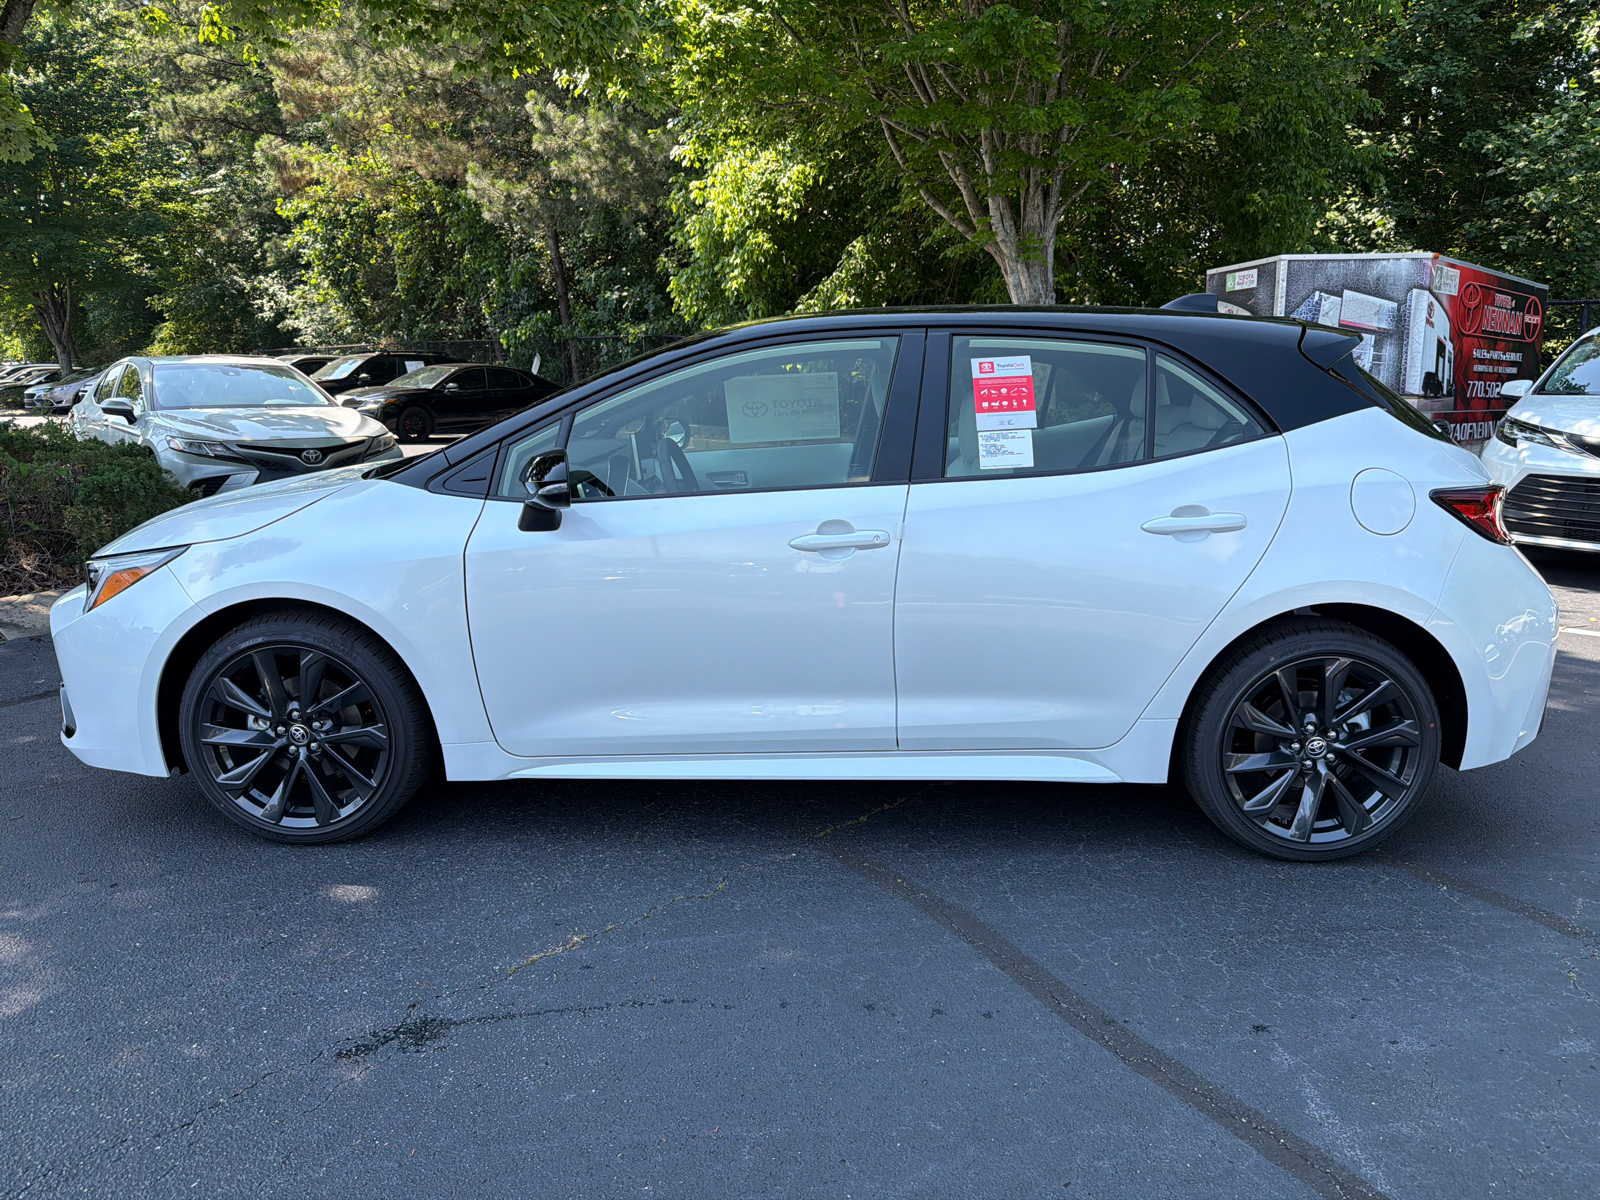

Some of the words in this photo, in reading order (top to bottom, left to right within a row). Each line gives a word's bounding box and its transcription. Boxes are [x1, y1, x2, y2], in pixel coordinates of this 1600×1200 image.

[1494, 293, 1512, 309] TOYOTA
[1482, 305, 1523, 335] NEWNAN
[1473, 348, 1487, 359] SALES
[1505, 351, 1523, 362] SERVICE
[771, 399, 823, 409] TOYOTA
[313, 635, 358, 662] YOKOHAMA
[1279, 643, 1312, 659] AVID
